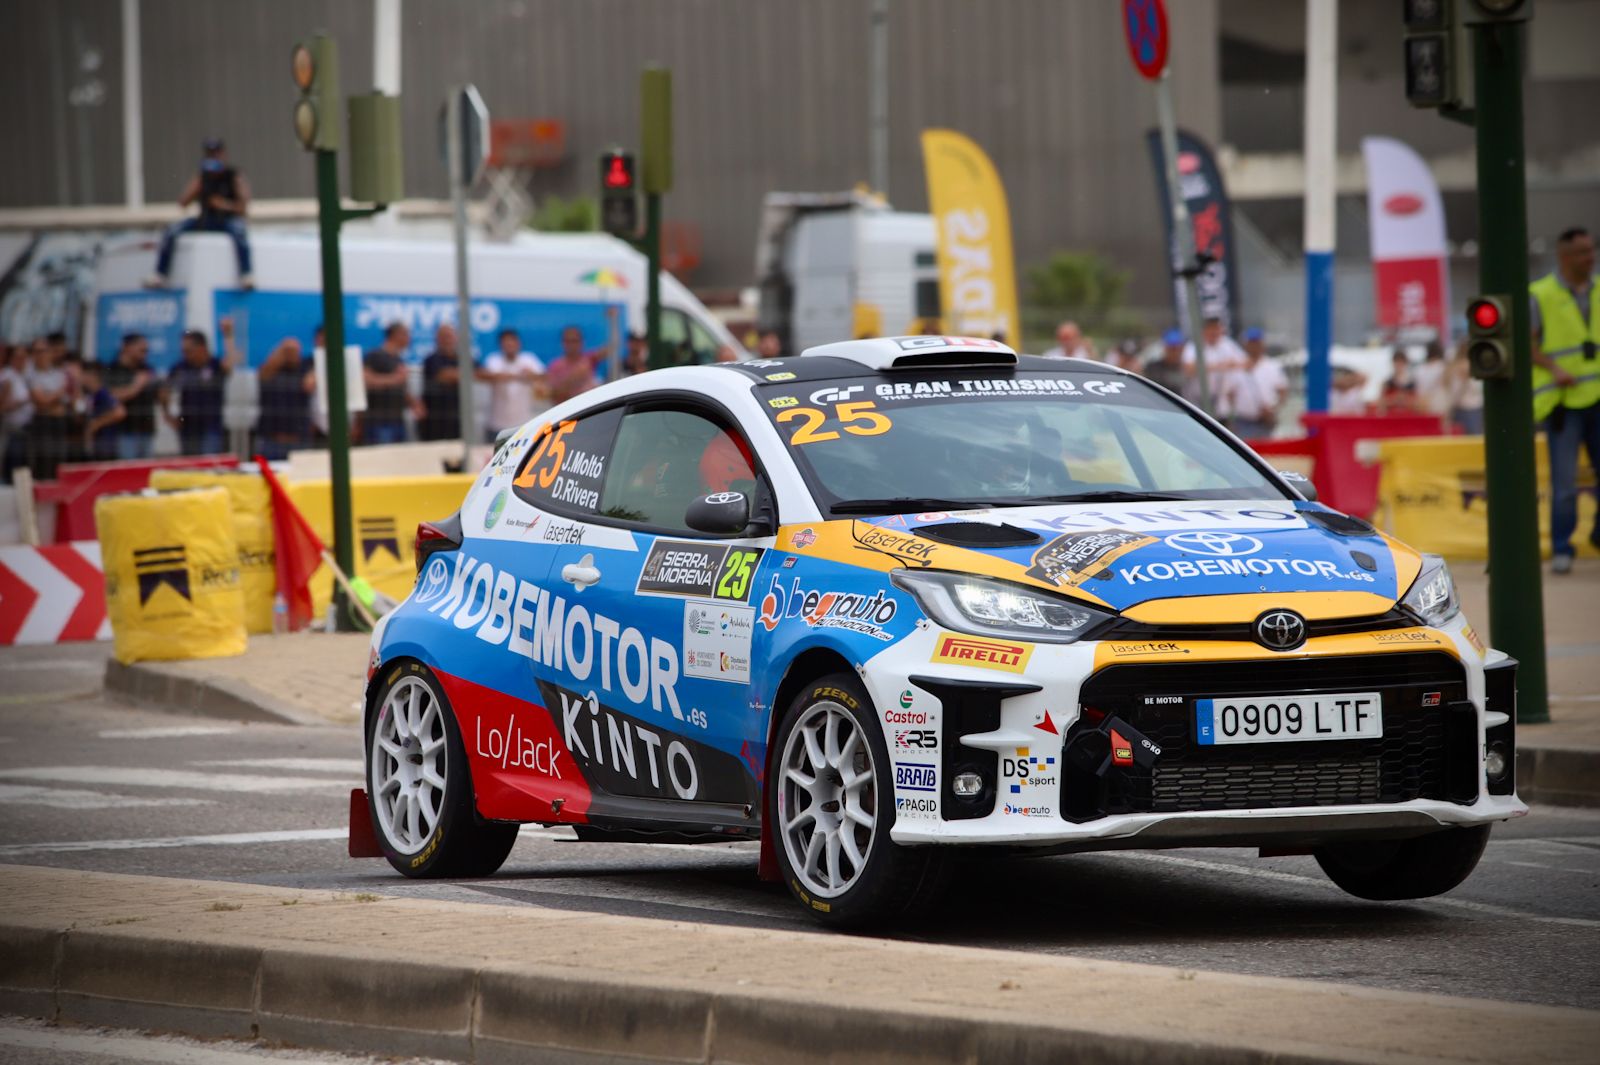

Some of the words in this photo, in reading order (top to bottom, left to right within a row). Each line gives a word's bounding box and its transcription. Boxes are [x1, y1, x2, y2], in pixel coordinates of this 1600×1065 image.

[875, 381, 952, 396] GRAN
[958, 378, 1076, 392] TURISMO
[912, 392, 949, 400] REAL
[951, 390, 1008, 398] DRIVING
[1009, 389, 1084, 397] SIMULATOR
[776, 401, 893, 446] 25
[512, 419, 577, 488] 25
[562, 449, 605, 479] J.Moltó
[551, 476, 599, 510] D.Rivera
[543, 519, 587, 546] lasertek
[860, 527, 938, 558] lasertek
[1057, 533, 1111, 561] SIERRA
[663, 550, 709, 569] SIERRA
[657, 567, 713, 587] MORENA
[717, 550, 758, 599] 25
[1368, 632, 1432, 642] lasertek
[939, 637, 1025, 666] PIRELLI
[1110, 641, 1181, 654] lasertek
[1145, 697, 1154, 705] BE
[1156, 696, 1183, 704] MOTOR
[885, 710, 927, 725] Castrol
[1221, 702, 1303, 737] 0909
[1315, 699, 1371, 734] LTF
[895, 730, 938, 749] KRS
[1202, 726, 1210, 736] E
[1150, 744, 1161, 756] KO
[896, 767, 937, 787] BRAID
[1003, 758, 1030, 778] DS
[1029, 776, 1056, 787] sport
[905, 798, 937, 812] PAGID
